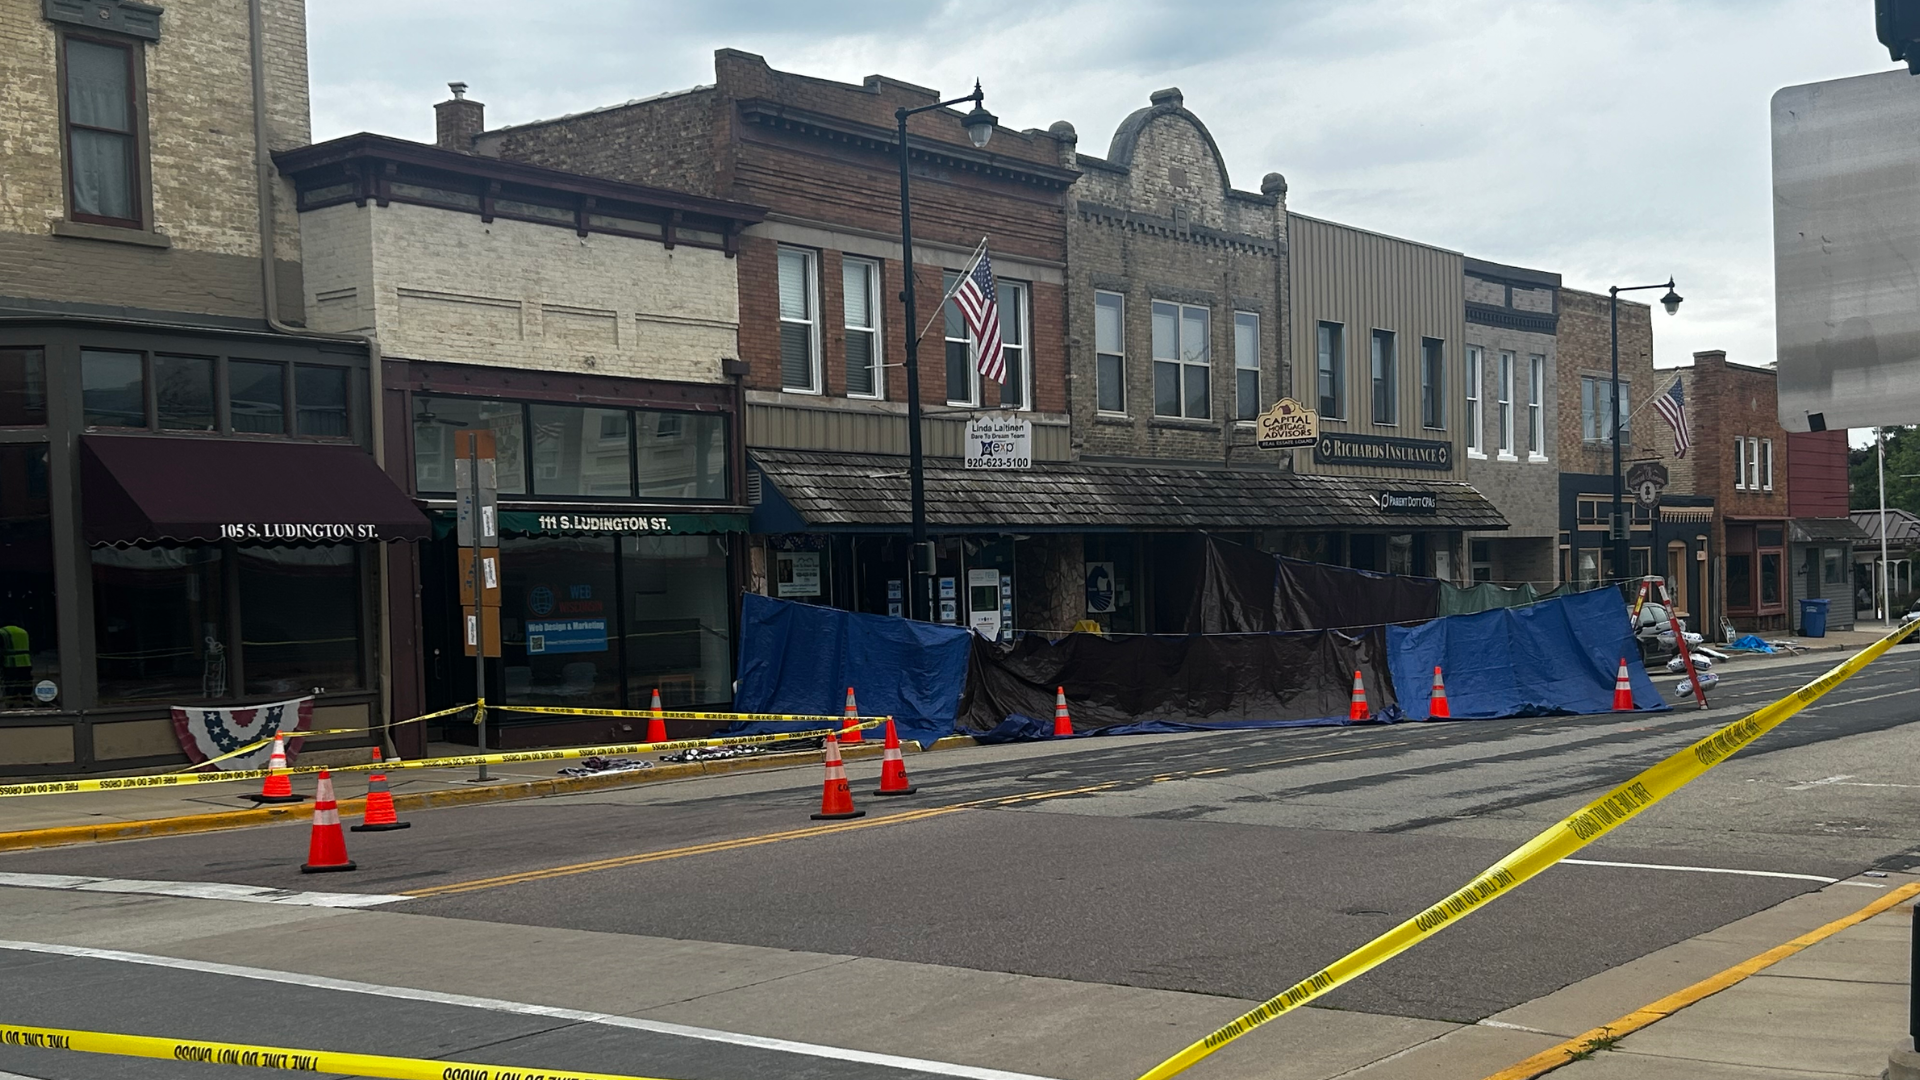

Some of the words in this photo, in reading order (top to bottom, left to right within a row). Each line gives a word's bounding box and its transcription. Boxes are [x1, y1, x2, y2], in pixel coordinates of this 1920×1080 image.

[1263, 415, 1311, 427] CAPITAL
[972, 424, 992, 432] Linda
[1269, 423, 1306, 432] MORTGAGE
[1264, 429, 1312, 439] ADVISORS
[1386, 443, 1436, 462] INSURANCE
[967, 458, 1028, 468] 920-623-5100
[539, 516, 557, 529] 111
[650, 518, 671, 530] ST.
[220, 524, 244, 538] 105
[248, 524, 260, 537] S.
[264, 524, 354, 538] LUDINGTON
[358, 524, 378, 538] ST.
[570, 584, 592, 599] WEB
[528, 624, 544, 632] Web
[544, 622, 566, 632] Design
[572, 621, 604, 630] Marketing
[137, 778, 147, 786] DO
[148, 777, 162, 785] LINE
[163, 776, 178, 784] FIRE
[198, 774, 220, 782] CROSS
[48, 784, 62, 792] LINE
[64, 783, 78, 791] FIRE
[100, 780, 122, 788] CROSS
[23, 786, 36, 794] NOT
